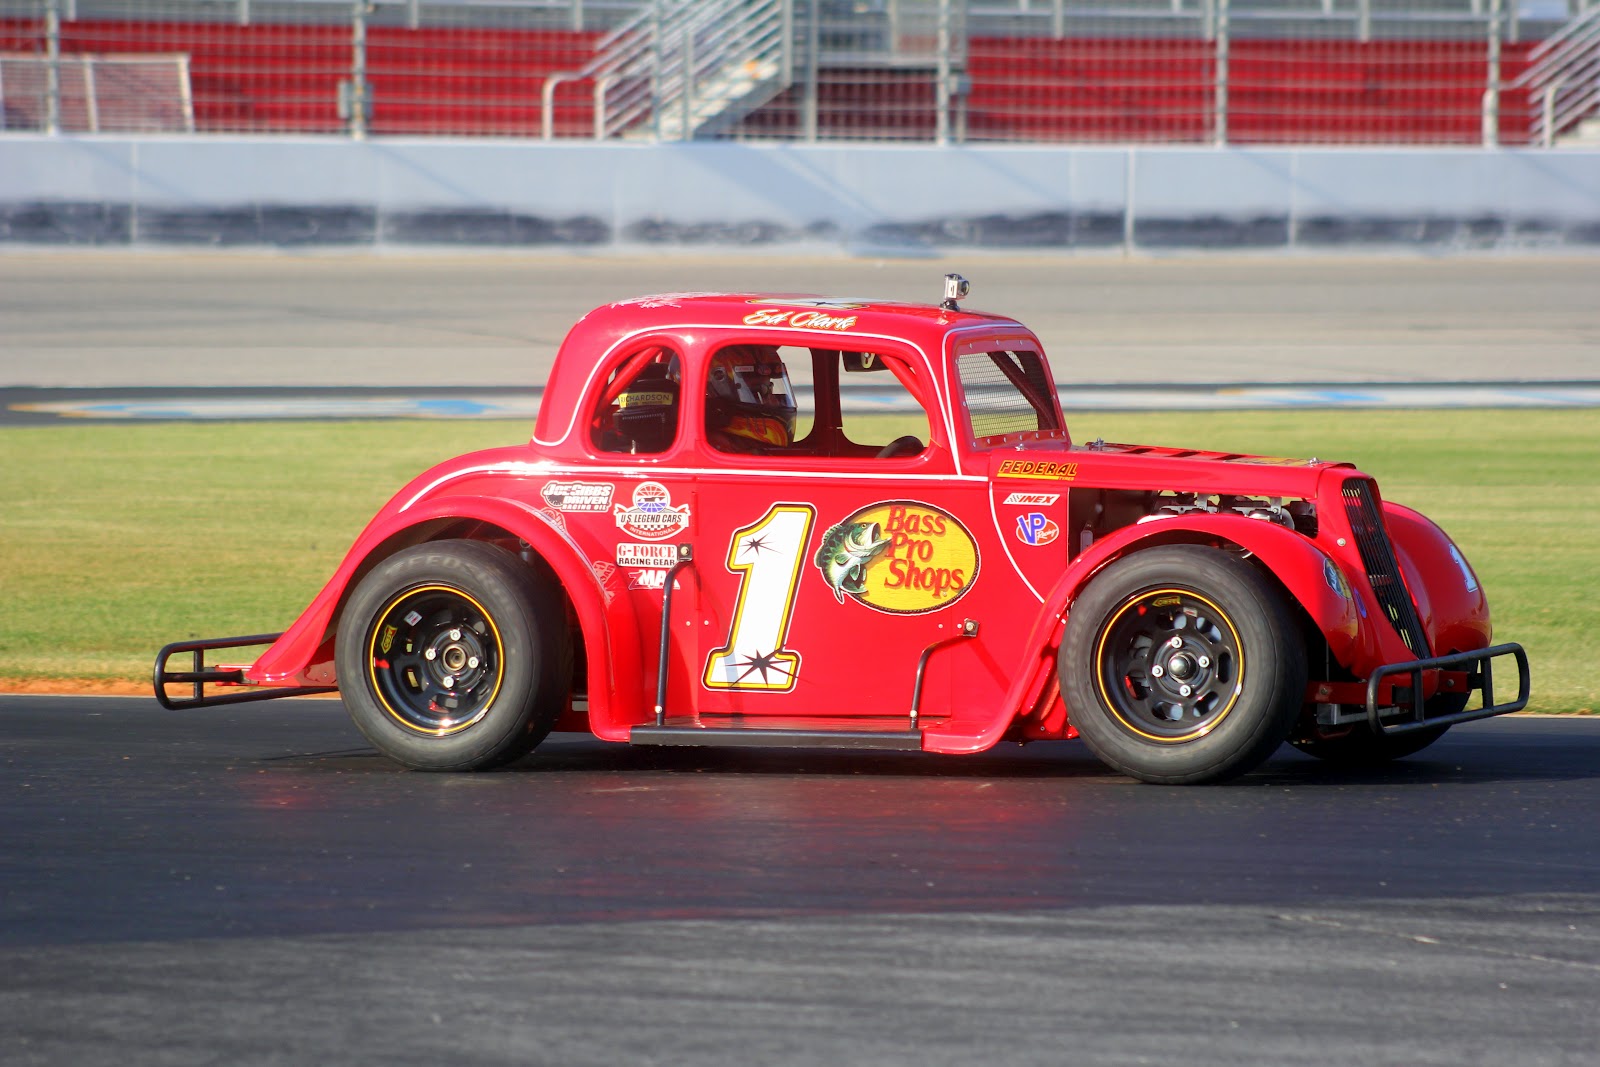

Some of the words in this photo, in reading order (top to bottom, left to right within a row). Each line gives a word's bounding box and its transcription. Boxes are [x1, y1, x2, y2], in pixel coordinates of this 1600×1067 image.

[743, 309, 795, 325] Ed
[790, 311, 858, 331] Clark
[620, 394, 670, 404] RICHARDSON
[998, 460, 1078, 476] FEDERAL
[563, 496, 609, 505] DRIVEN
[1018, 495, 1056, 503] INEX
[633, 514, 661, 523] LEGEND
[661, 514, 682, 523] CARS
[884, 505, 948, 535] Bass
[629, 526, 676, 537] INTERNATIONAL
[1016, 512, 1047, 545] VP
[618, 545, 675, 558] G-FORCE
[886, 531, 934, 561] Pro
[618, 557, 651, 566] RACING
[653, 558, 675, 566] GEAR
[884, 558, 965, 598] Shops
[702, 502, 818, 694] 1
